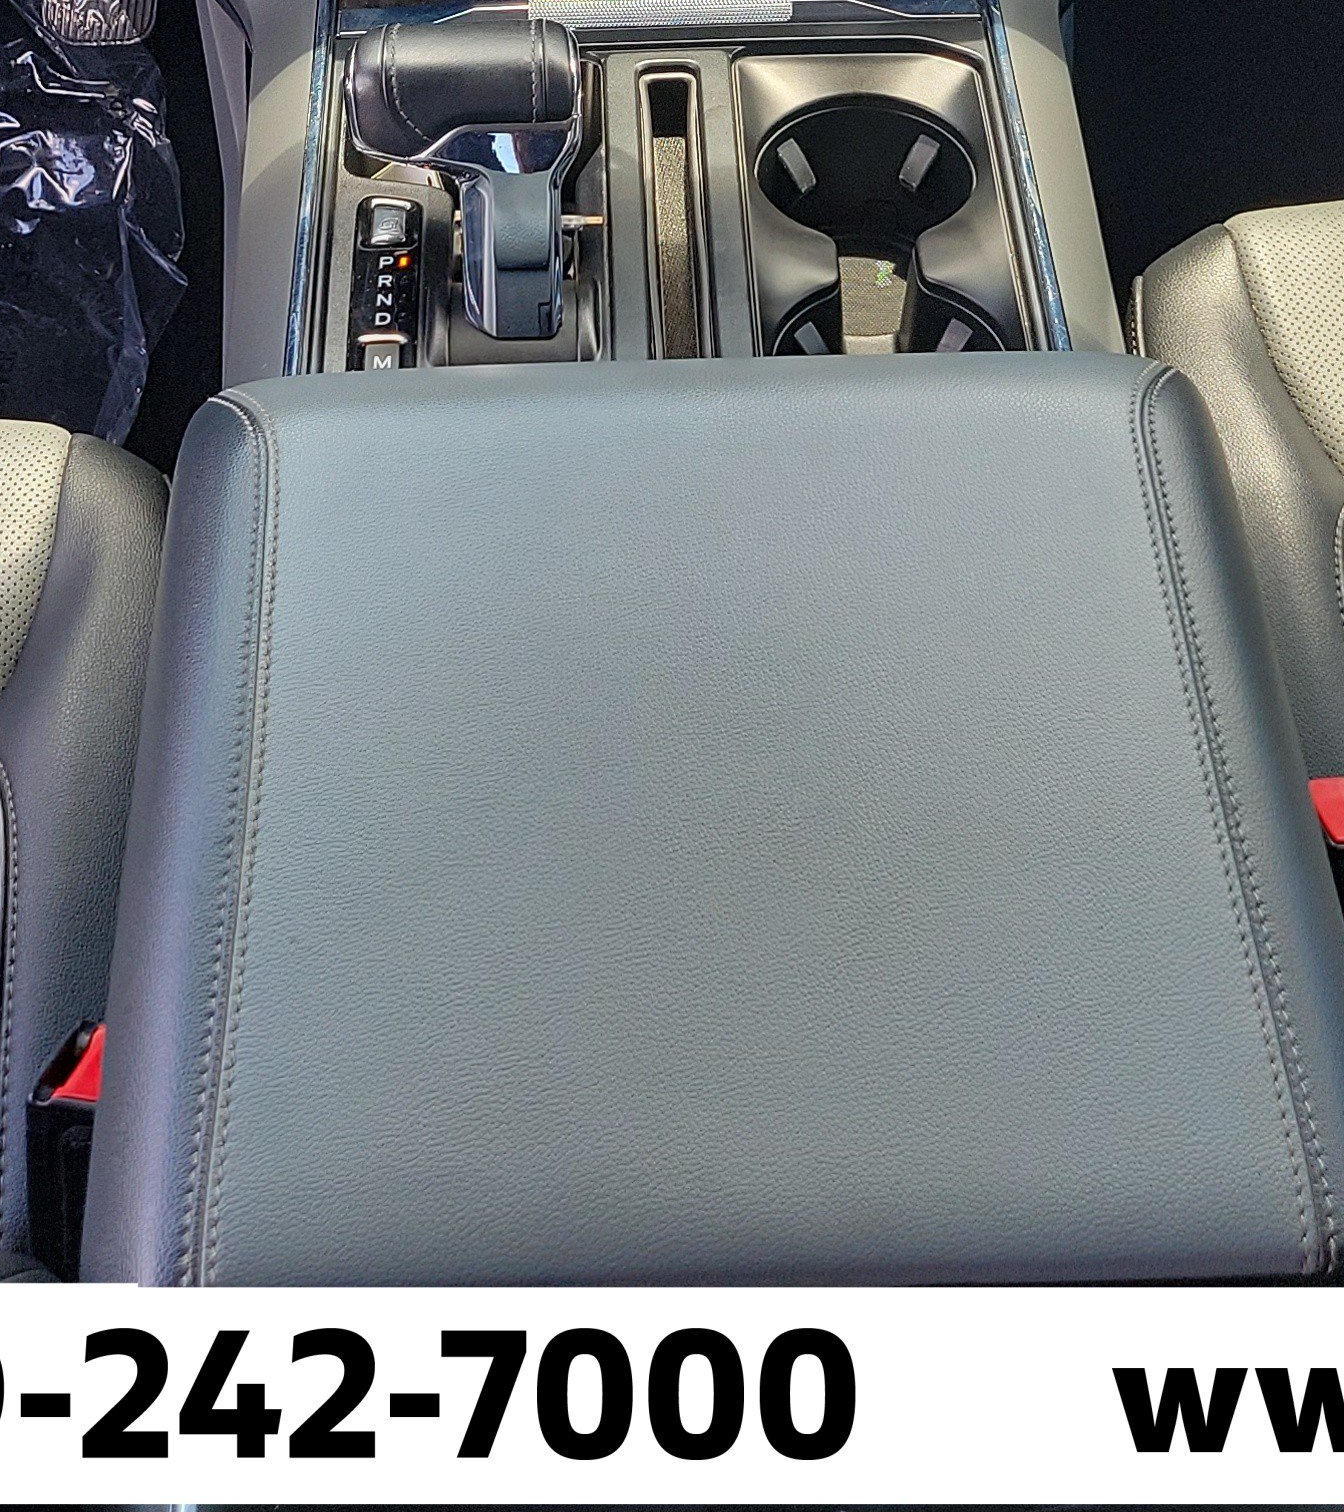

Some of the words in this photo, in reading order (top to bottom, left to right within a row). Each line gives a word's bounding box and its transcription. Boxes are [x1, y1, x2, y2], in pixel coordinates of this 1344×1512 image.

[378, 256, 394, 269] P
[377, 275, 393, 288] R
[376, 293, 393, 307] N
[374, 312, 392, 326] D
[373, 355, 393, 369] M
